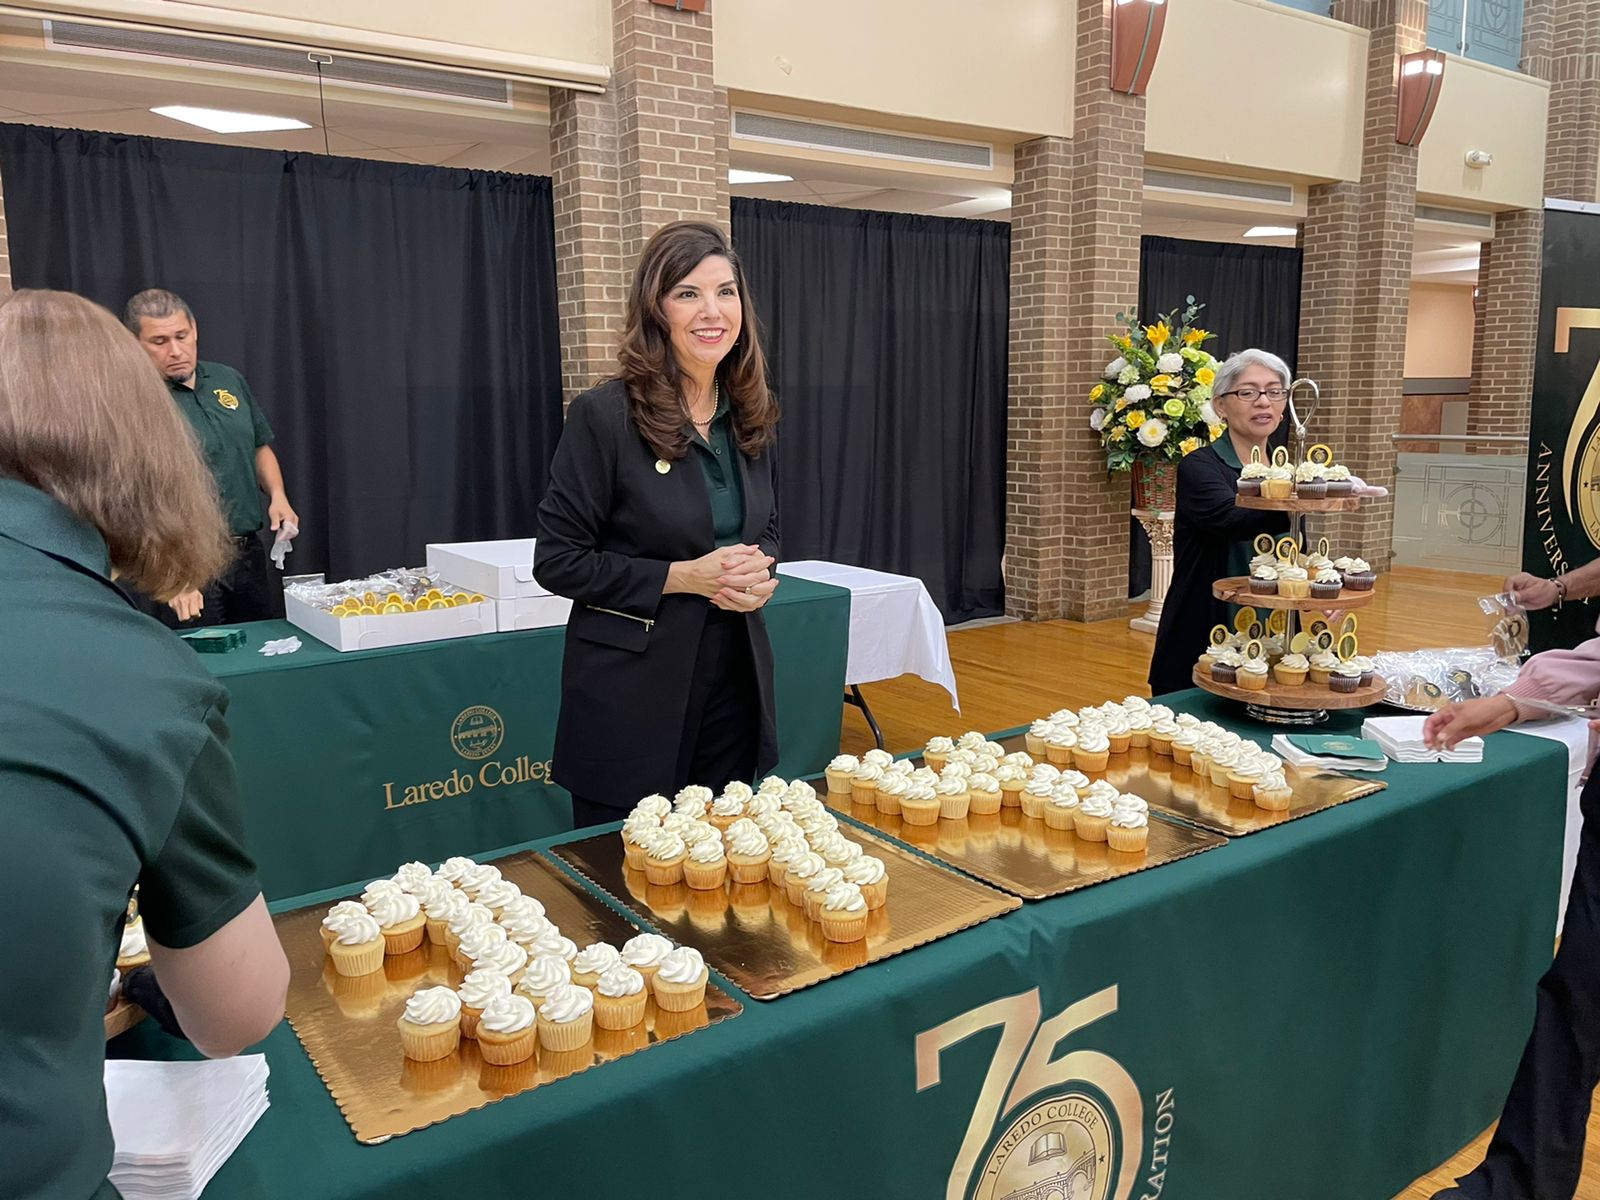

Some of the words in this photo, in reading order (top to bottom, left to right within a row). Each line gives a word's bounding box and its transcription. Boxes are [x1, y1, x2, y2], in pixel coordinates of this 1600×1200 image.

[382, 769, 474, 810] Laredo
[479, 755, 555, 787] Colleg
[914, 983, 1144, 1200] 75
[988, 1110, 1042, 1176] LAREDO
[1046, 1101, 1100, 1131] COLLEGE
